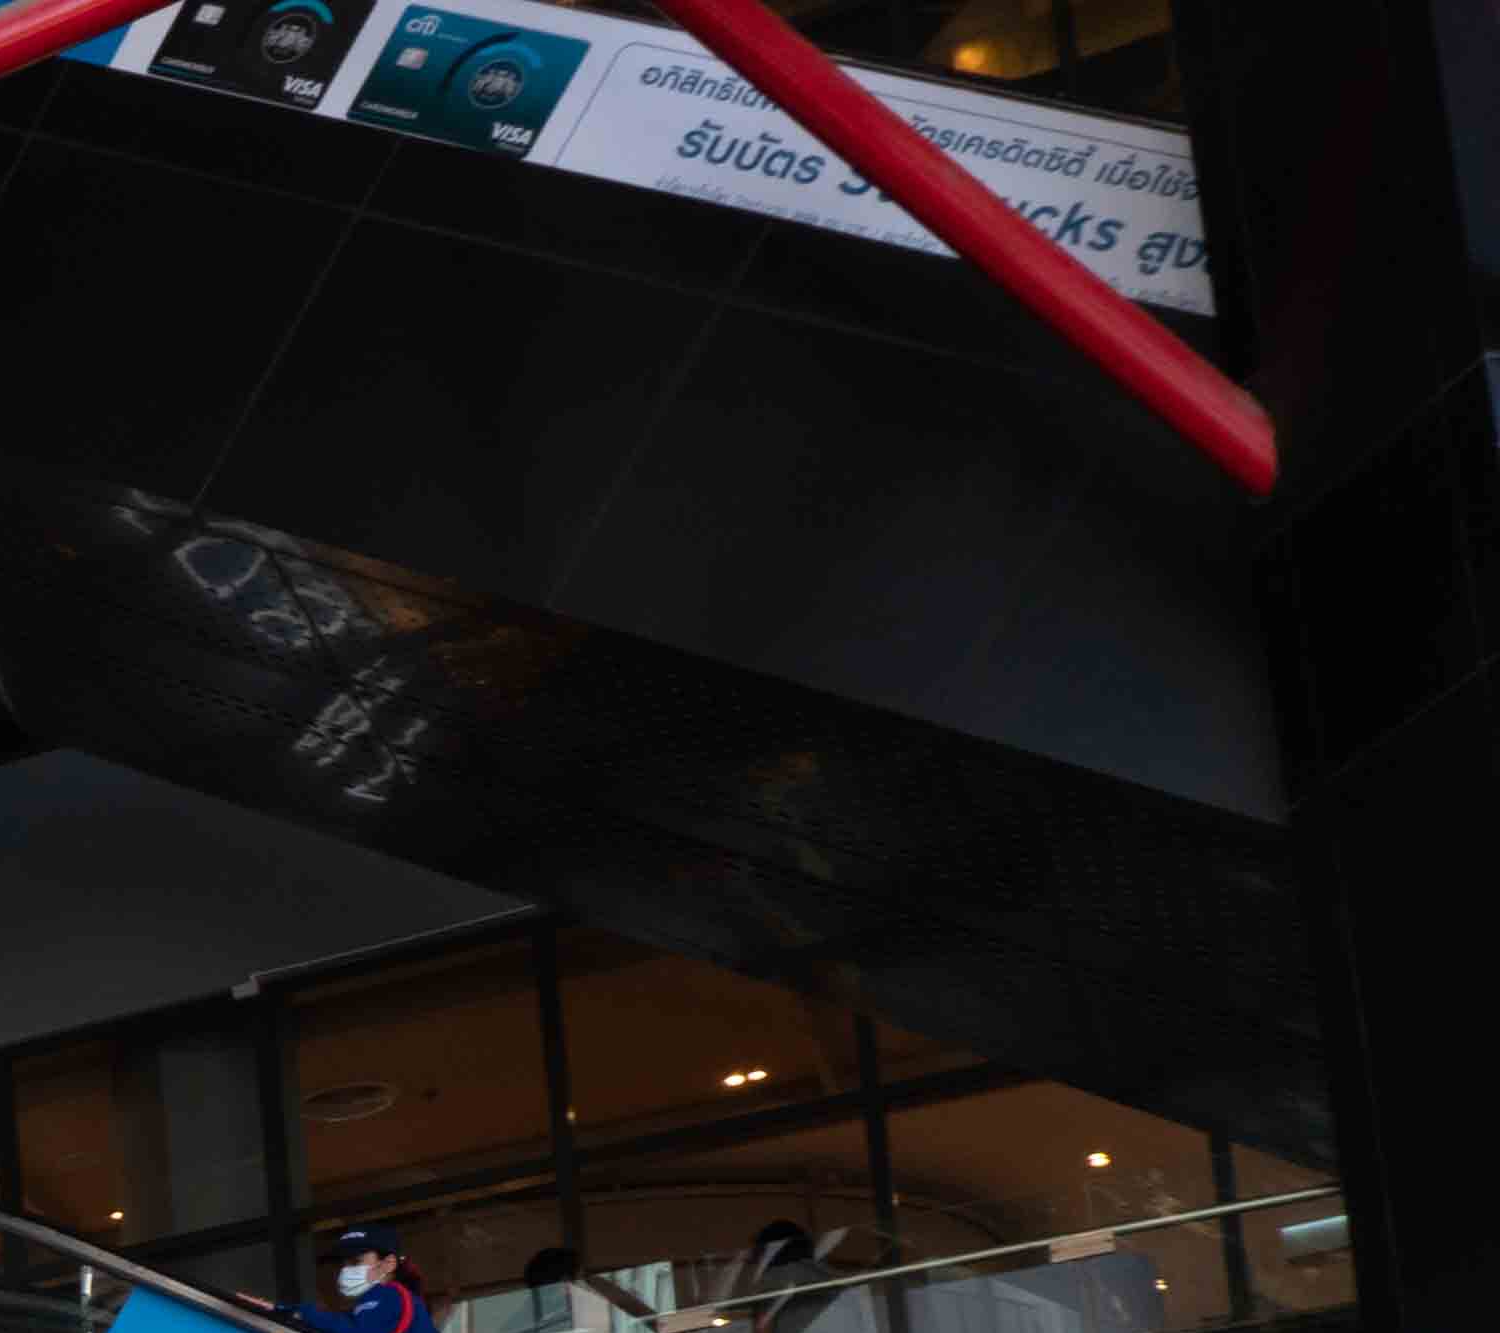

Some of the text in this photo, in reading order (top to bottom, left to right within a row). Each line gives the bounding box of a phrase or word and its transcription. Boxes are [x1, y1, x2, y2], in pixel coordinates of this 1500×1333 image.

[404, 13, 443, 38] citi
[282, 74, 325, 100] VISA
[490, 121, 532, 147] VISA
